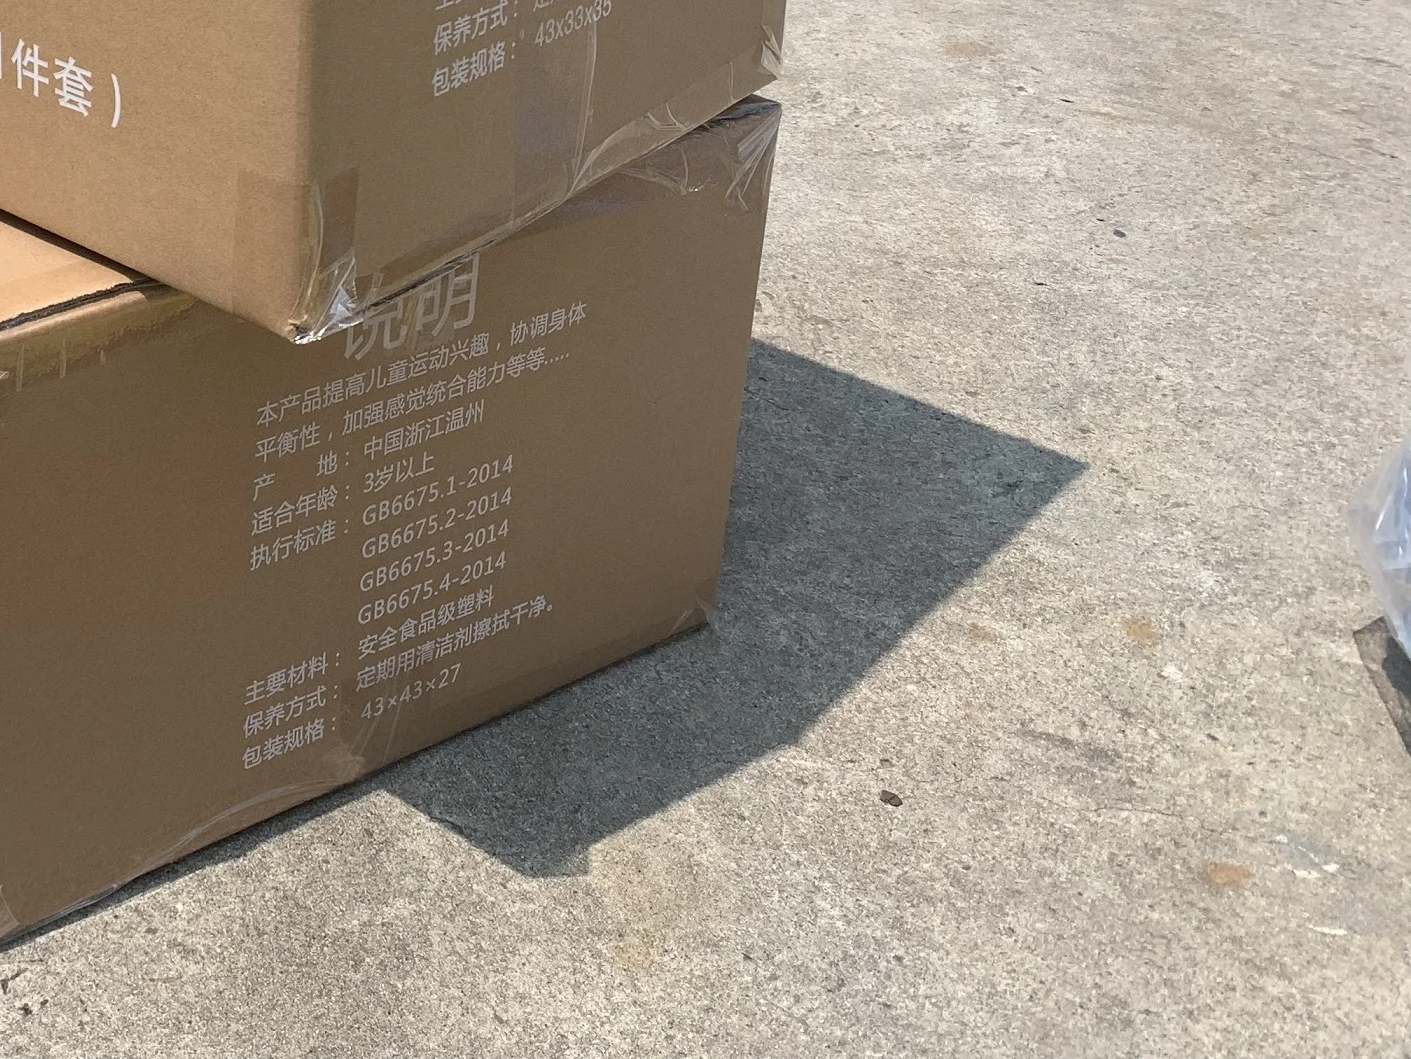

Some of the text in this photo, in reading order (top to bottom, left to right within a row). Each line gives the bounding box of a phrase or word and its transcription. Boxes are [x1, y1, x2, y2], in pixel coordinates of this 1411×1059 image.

[359, 519, 510, 592] GB6675.3-2014
[361, 487, 513, 559] GB6675.2-2014
[357, 551, 507, 625] GB6675.4-2014
